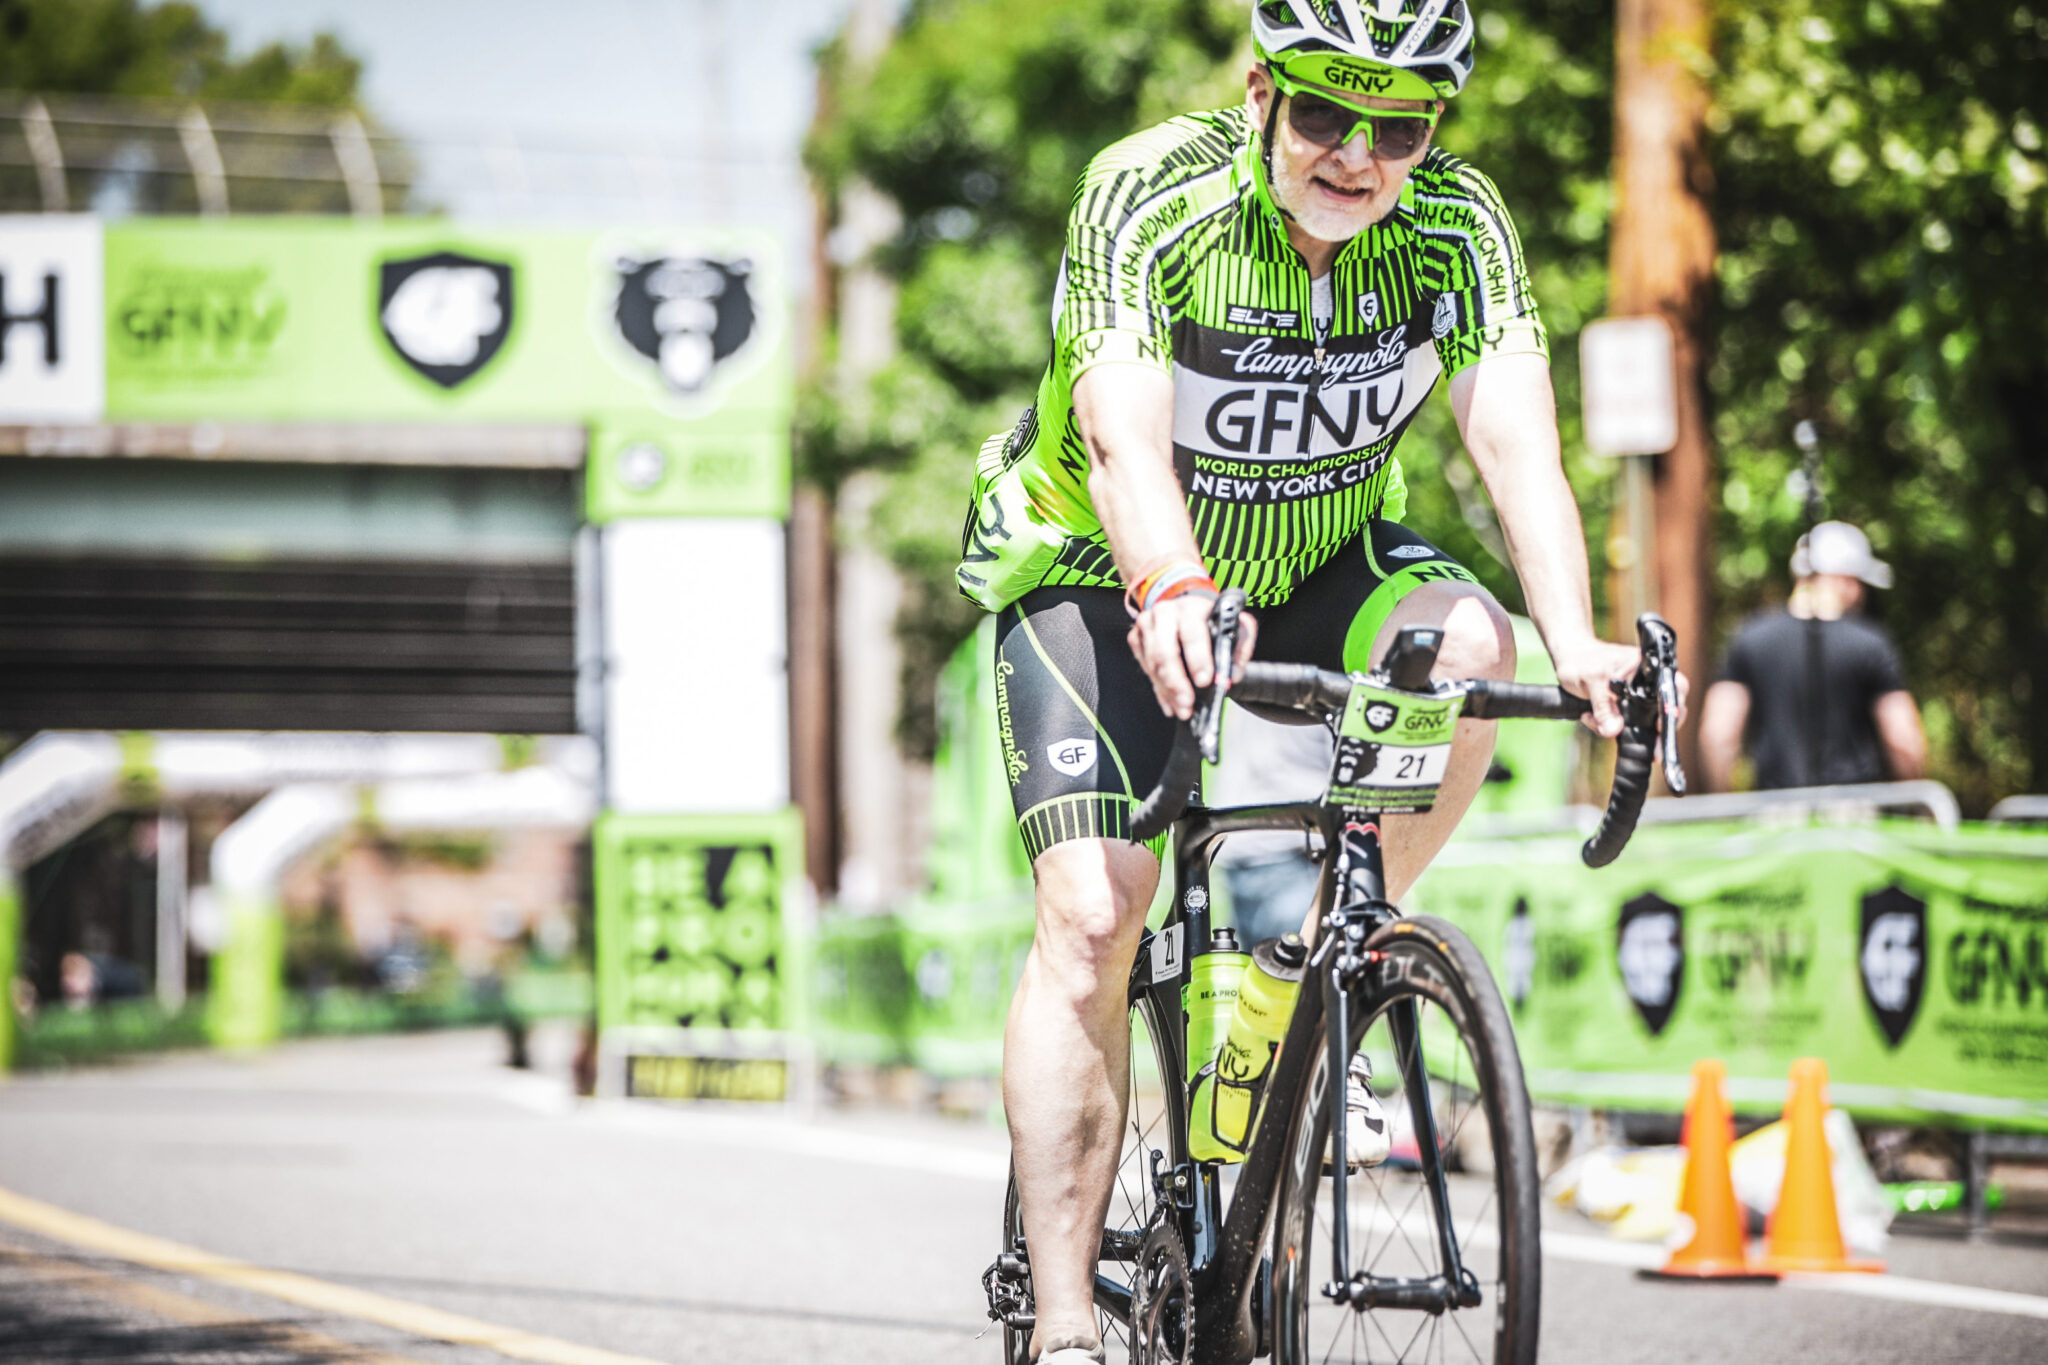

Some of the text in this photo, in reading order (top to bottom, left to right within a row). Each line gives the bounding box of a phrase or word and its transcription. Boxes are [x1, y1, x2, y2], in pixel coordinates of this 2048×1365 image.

[1324, 67, 1393, 93] GFNY
[1221, 325, 1407, 390] Campgnolo
[1205, 383, 1405, 455] GFNY
[1191, 444, 1391, 501] NEW YORK CITY
[1194, 455, 1264, 479] WORLD
[995, 644, 1029, 787] Campagnolo
[1396, 753, 1427, 779] 21
[1165, 929, 1174, 966] 21
[1219, 989, 1238, 998] PRO
